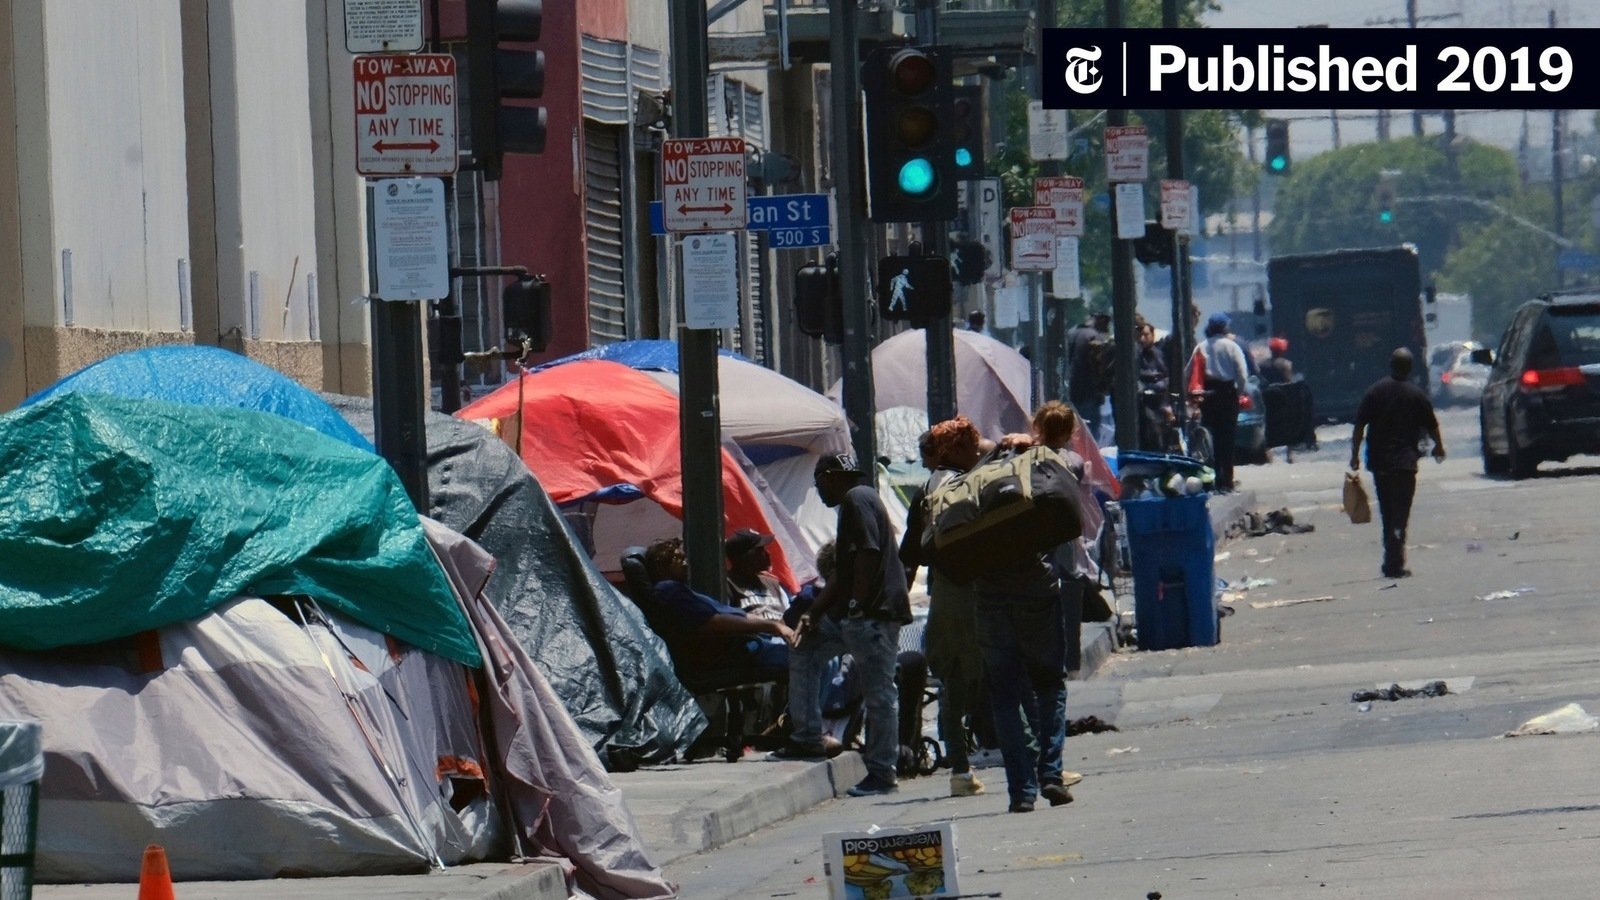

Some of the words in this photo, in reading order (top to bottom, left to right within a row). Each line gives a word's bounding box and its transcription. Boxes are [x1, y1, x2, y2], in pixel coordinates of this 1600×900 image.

[357, 58, 451, 75] TOW-AWAY
[357, 80, 384, 111] NO
[388, 84, 452, 106] STOPPING
[368, 118, 399, 137] ANY
[409, 118, 444, 136] TIME
[665, 140, 742, 154] TOW-AWAY
[665, 158, 687, 182] NO
[690, 160, 743, 178] STOPPING
[675, 187, 700, 201] ANY
[707, 187, 736, 201] TIME
[787, 200, 812, 221] St
[776, 231, 804, 246] 500
[812, 230, 820, 243] S
[845, 840, 879, 853] Gold
